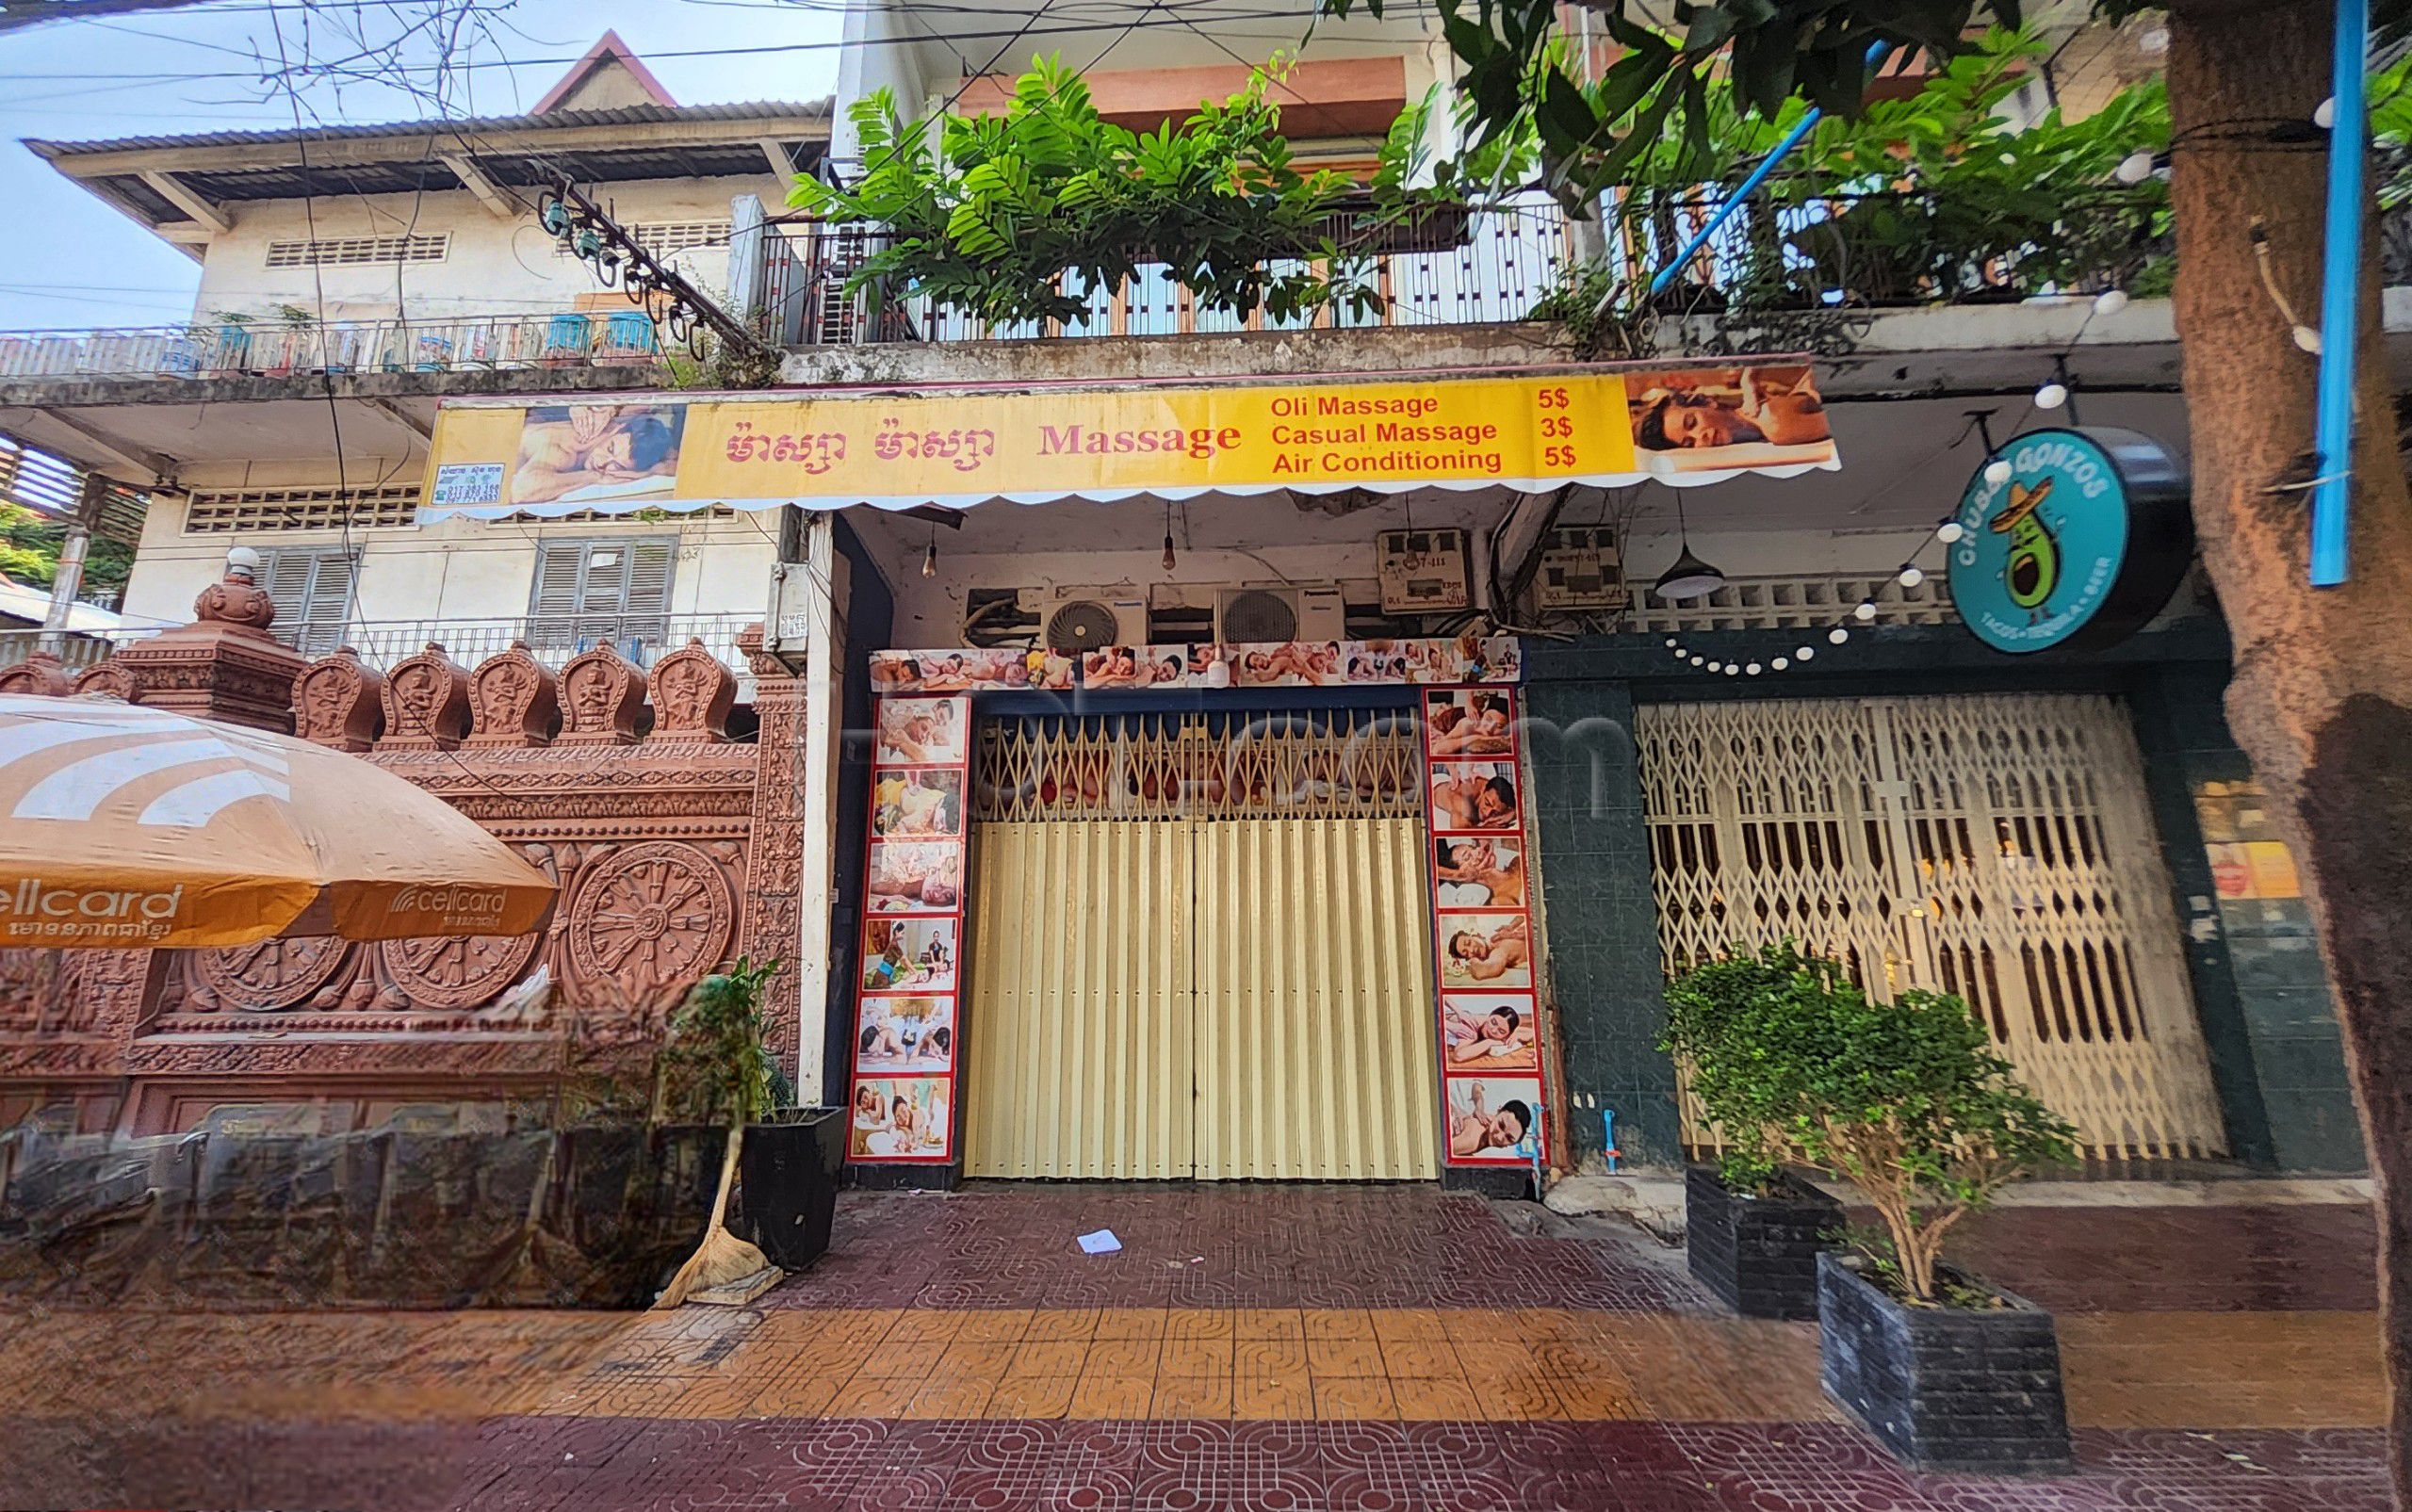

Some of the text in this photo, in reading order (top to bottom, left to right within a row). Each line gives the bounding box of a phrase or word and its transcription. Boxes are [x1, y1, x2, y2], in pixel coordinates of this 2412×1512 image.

[1271, 395, 1439, 418] Oli Massage
[1538, 387, 1571, 410] 5$
[1272, 423, 1498, 446] Casual Massage
[1540, 415, 1574, 439] 3$
[1035, 422, 1243, 460] Massage
[1272, 449, 1502, 474] Air Conditioning
[1544, 444, 1577, 468] 5$
[2015, 442, 2110, 499] GONZOS
[417, 884, 508, 913] cellcard
